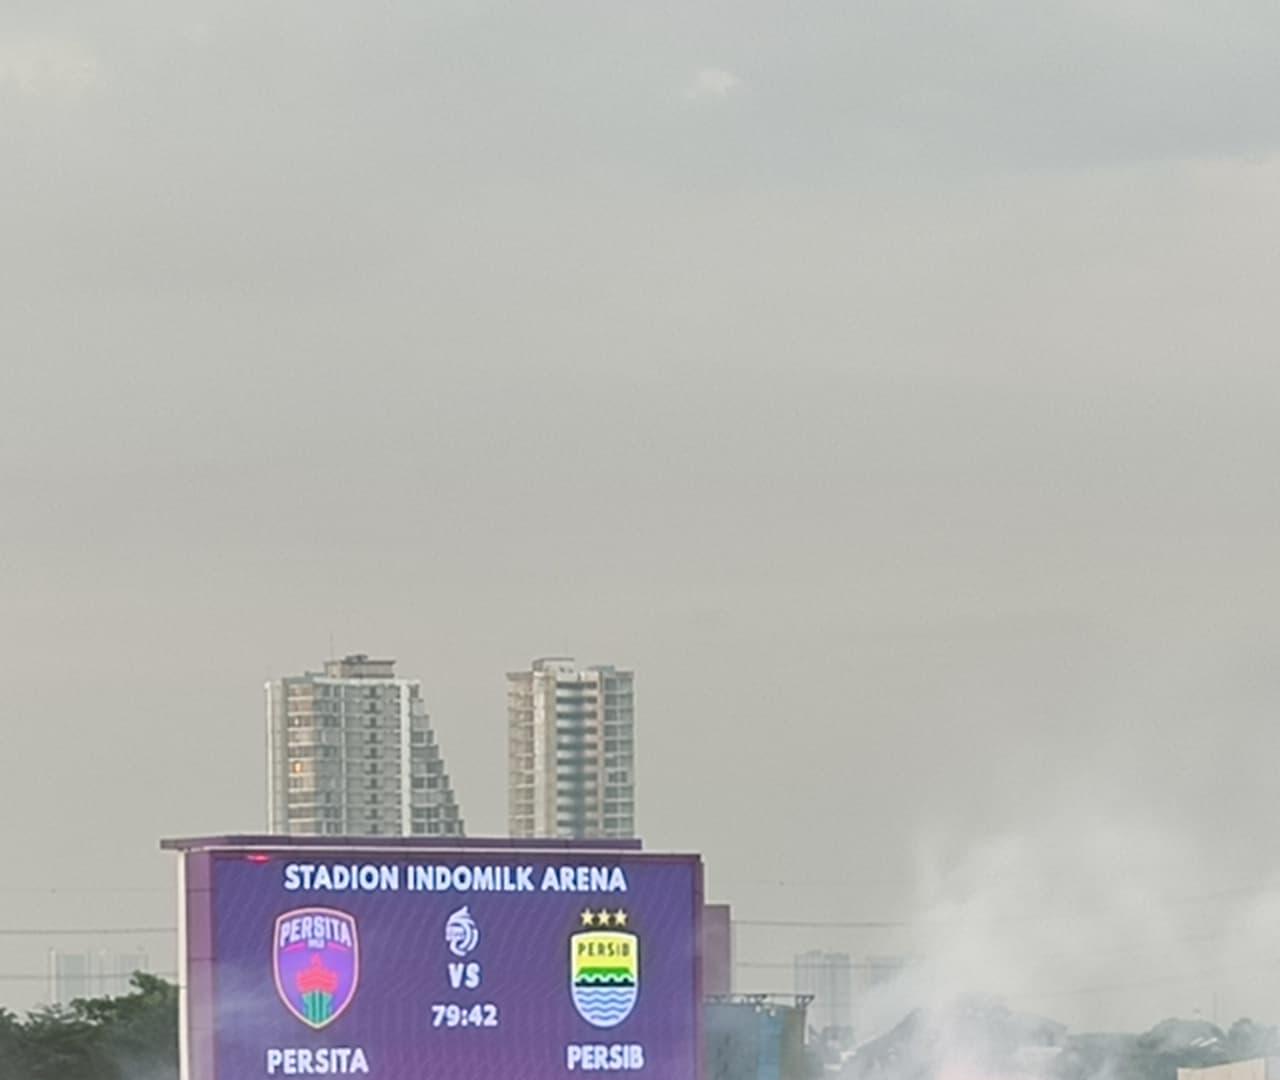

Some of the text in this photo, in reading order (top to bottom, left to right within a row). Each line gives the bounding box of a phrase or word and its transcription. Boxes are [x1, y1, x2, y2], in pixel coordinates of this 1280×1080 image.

[284, 864, 627, 891] STADION INDOMILK ARENA
[448, 963, 480, 988] VS
[431, 1004, 499, 1027] 79:42
[267, 1048, 369, 1074] PERSITA
[567, 1045, 645, 1070] PERSIB
